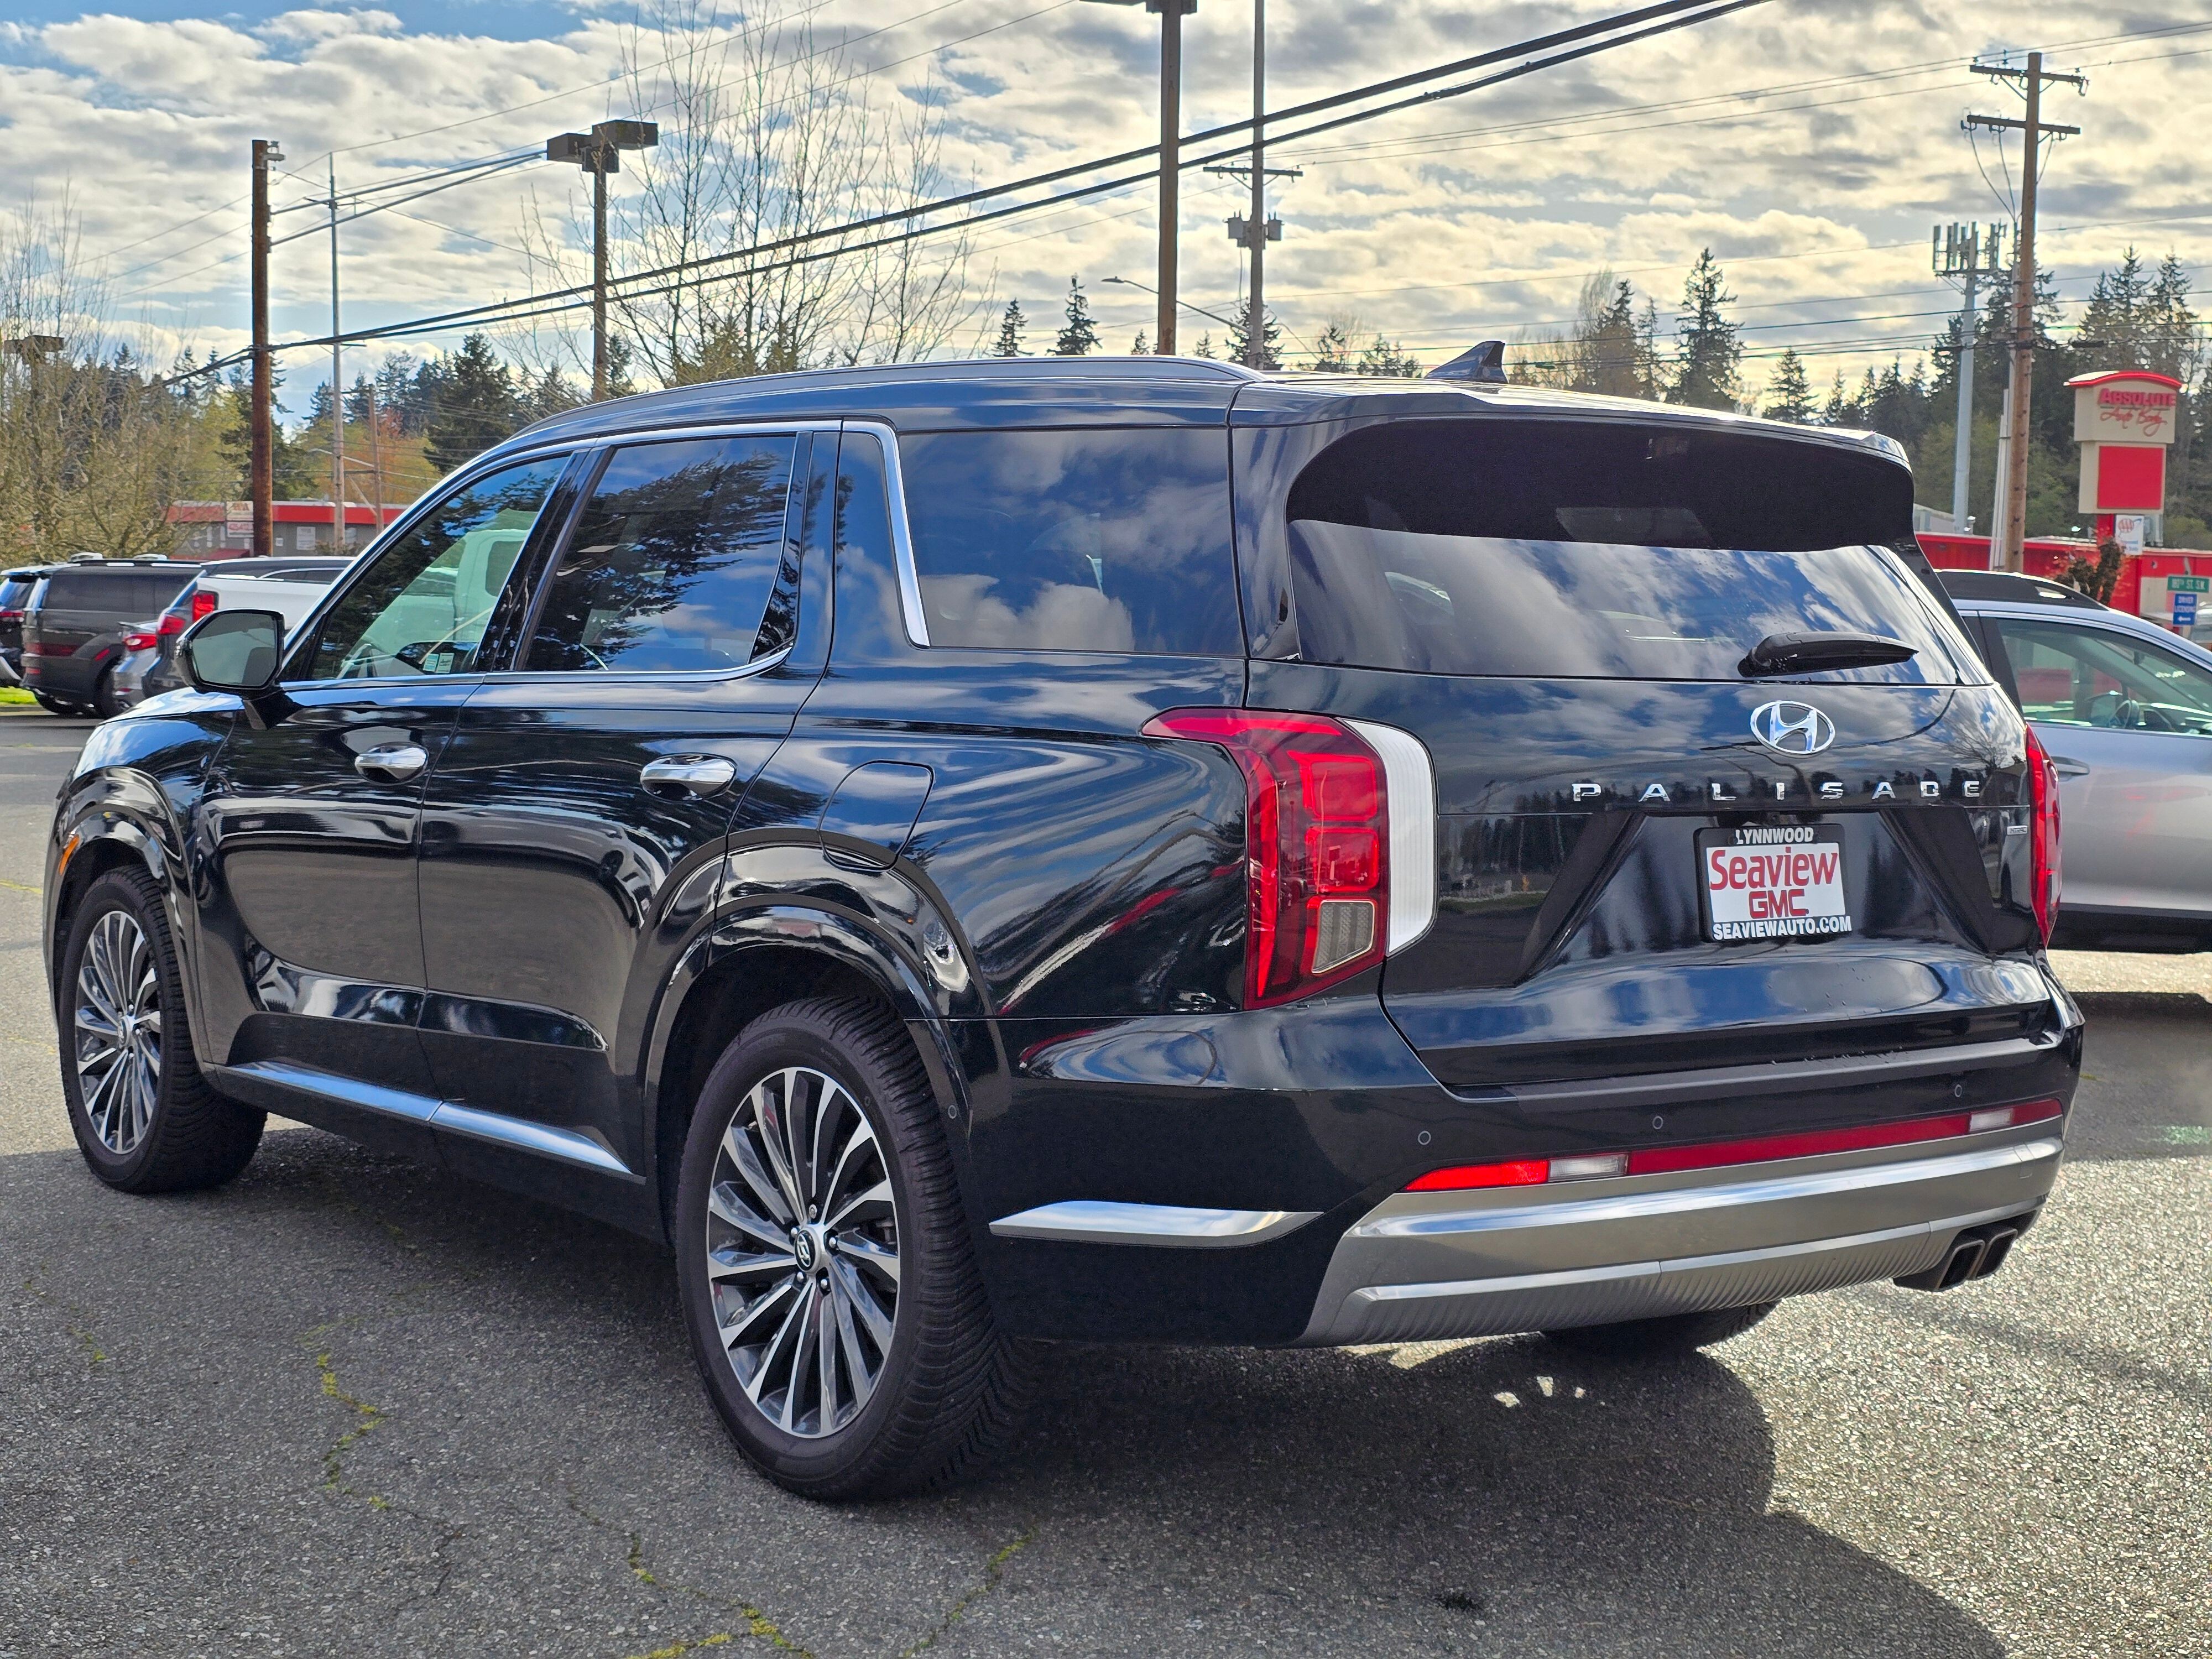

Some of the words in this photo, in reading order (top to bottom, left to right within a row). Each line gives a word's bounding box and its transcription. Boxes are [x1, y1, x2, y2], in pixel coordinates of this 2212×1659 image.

[2099, 388, 2177, 406] ABSOLUTE
[2100, 406, 2133, 429] Auto
[2136, 406, 2168, 437] Body
[1572, 780, 1981, 802] PALISADE
[1735, 827, 1814, 844] LYNNWOOD
[1709, 847, 1838, 890] Seaview
[1749, 889, 1809, 919] GMC
[1713, 916, 1852, 940] SEAVIEWAUTO.COM
